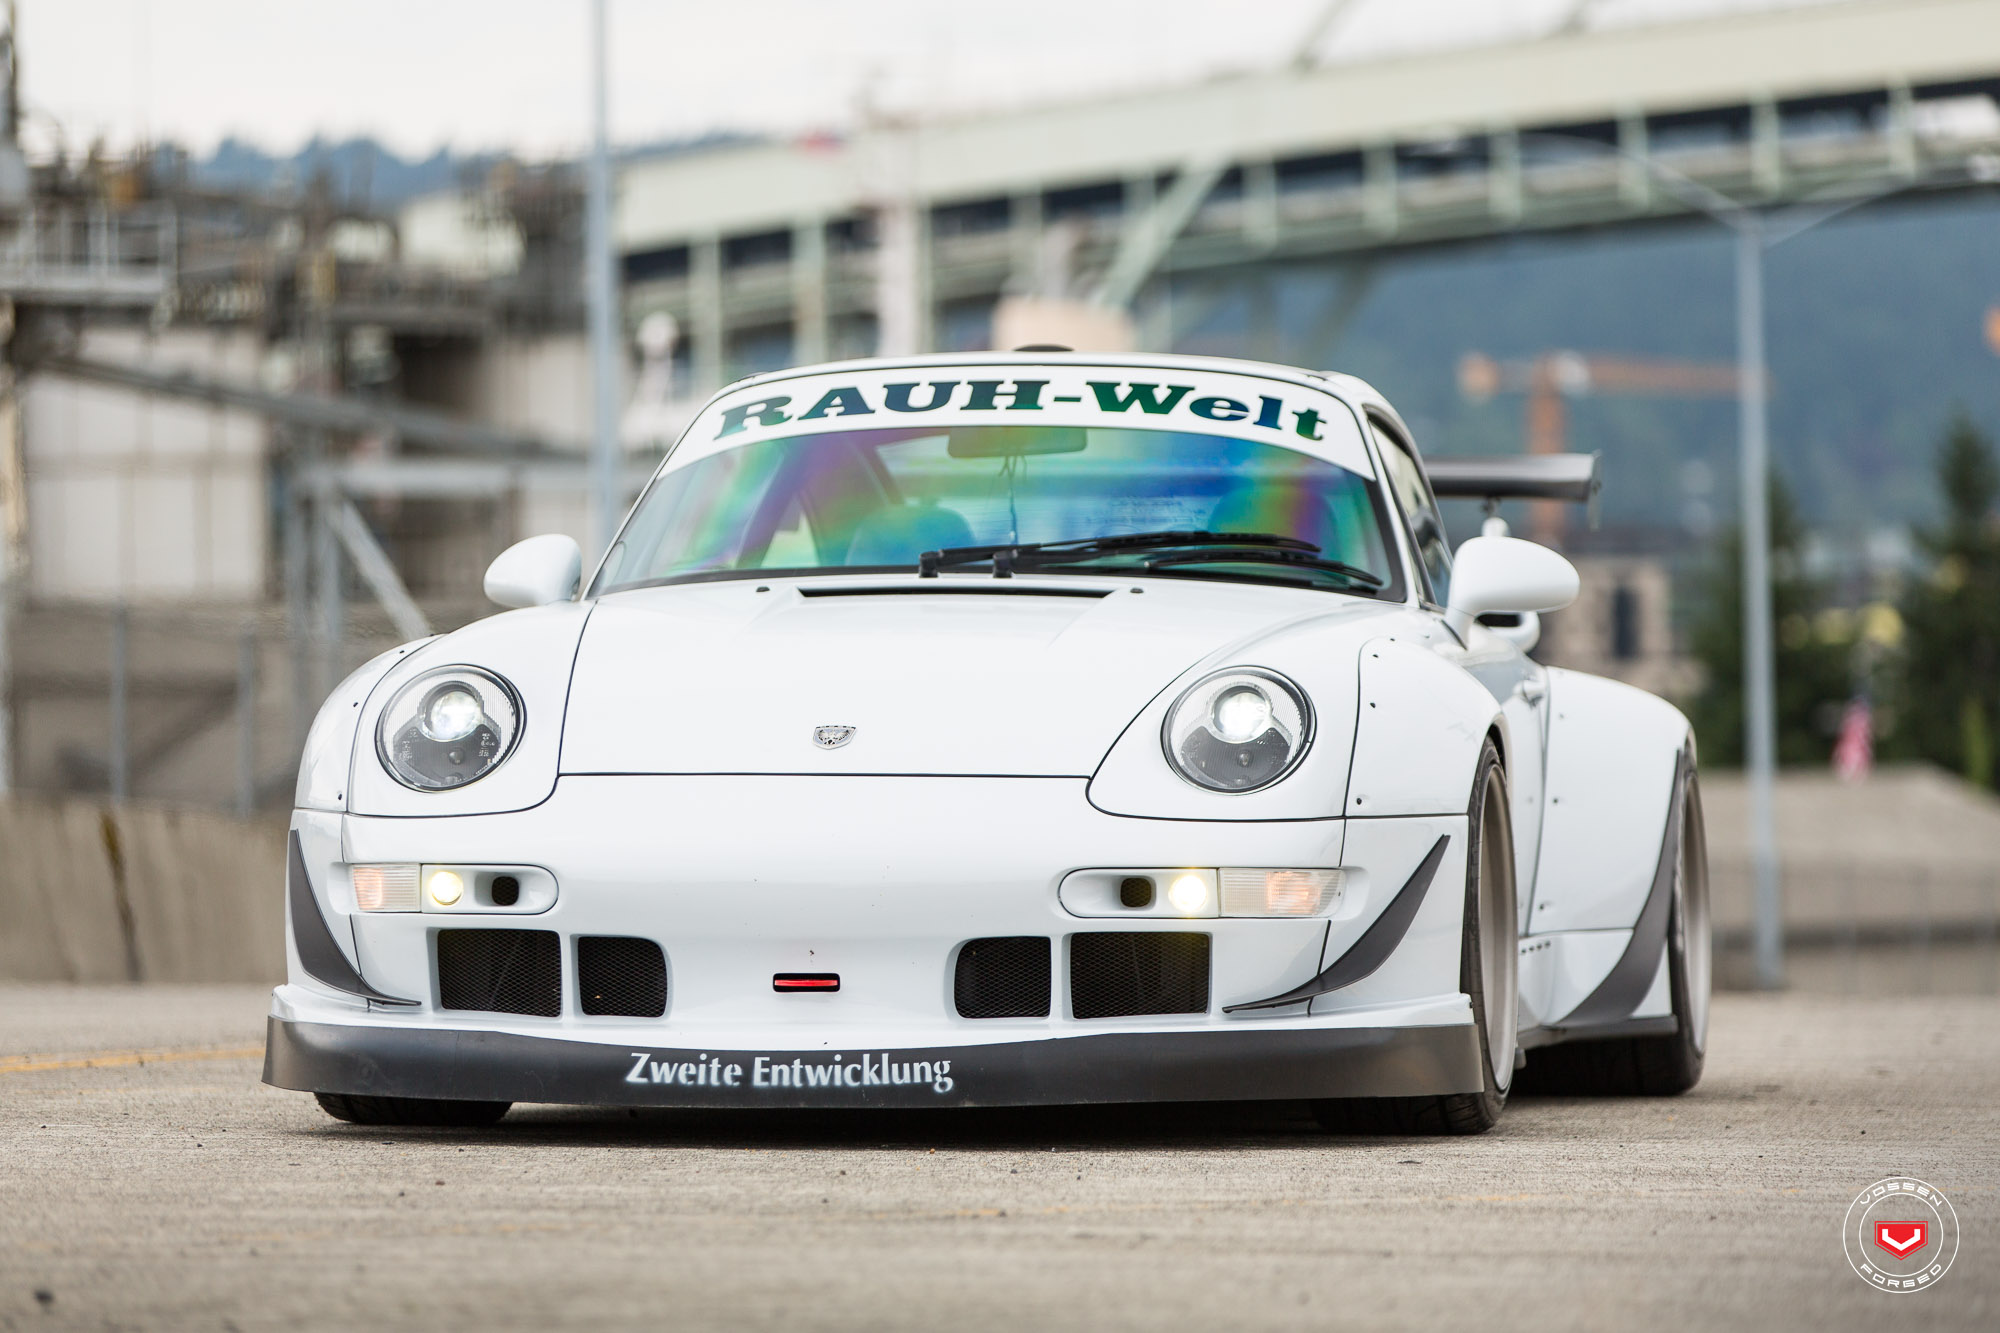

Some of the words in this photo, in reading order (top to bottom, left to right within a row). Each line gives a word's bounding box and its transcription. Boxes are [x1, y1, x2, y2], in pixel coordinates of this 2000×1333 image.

[713, 380, 1327, 441] RAUH-Welt
[625, 1052, 743, 1086] Zweite
[753, 1053, 954, 1093] Entwicklung
